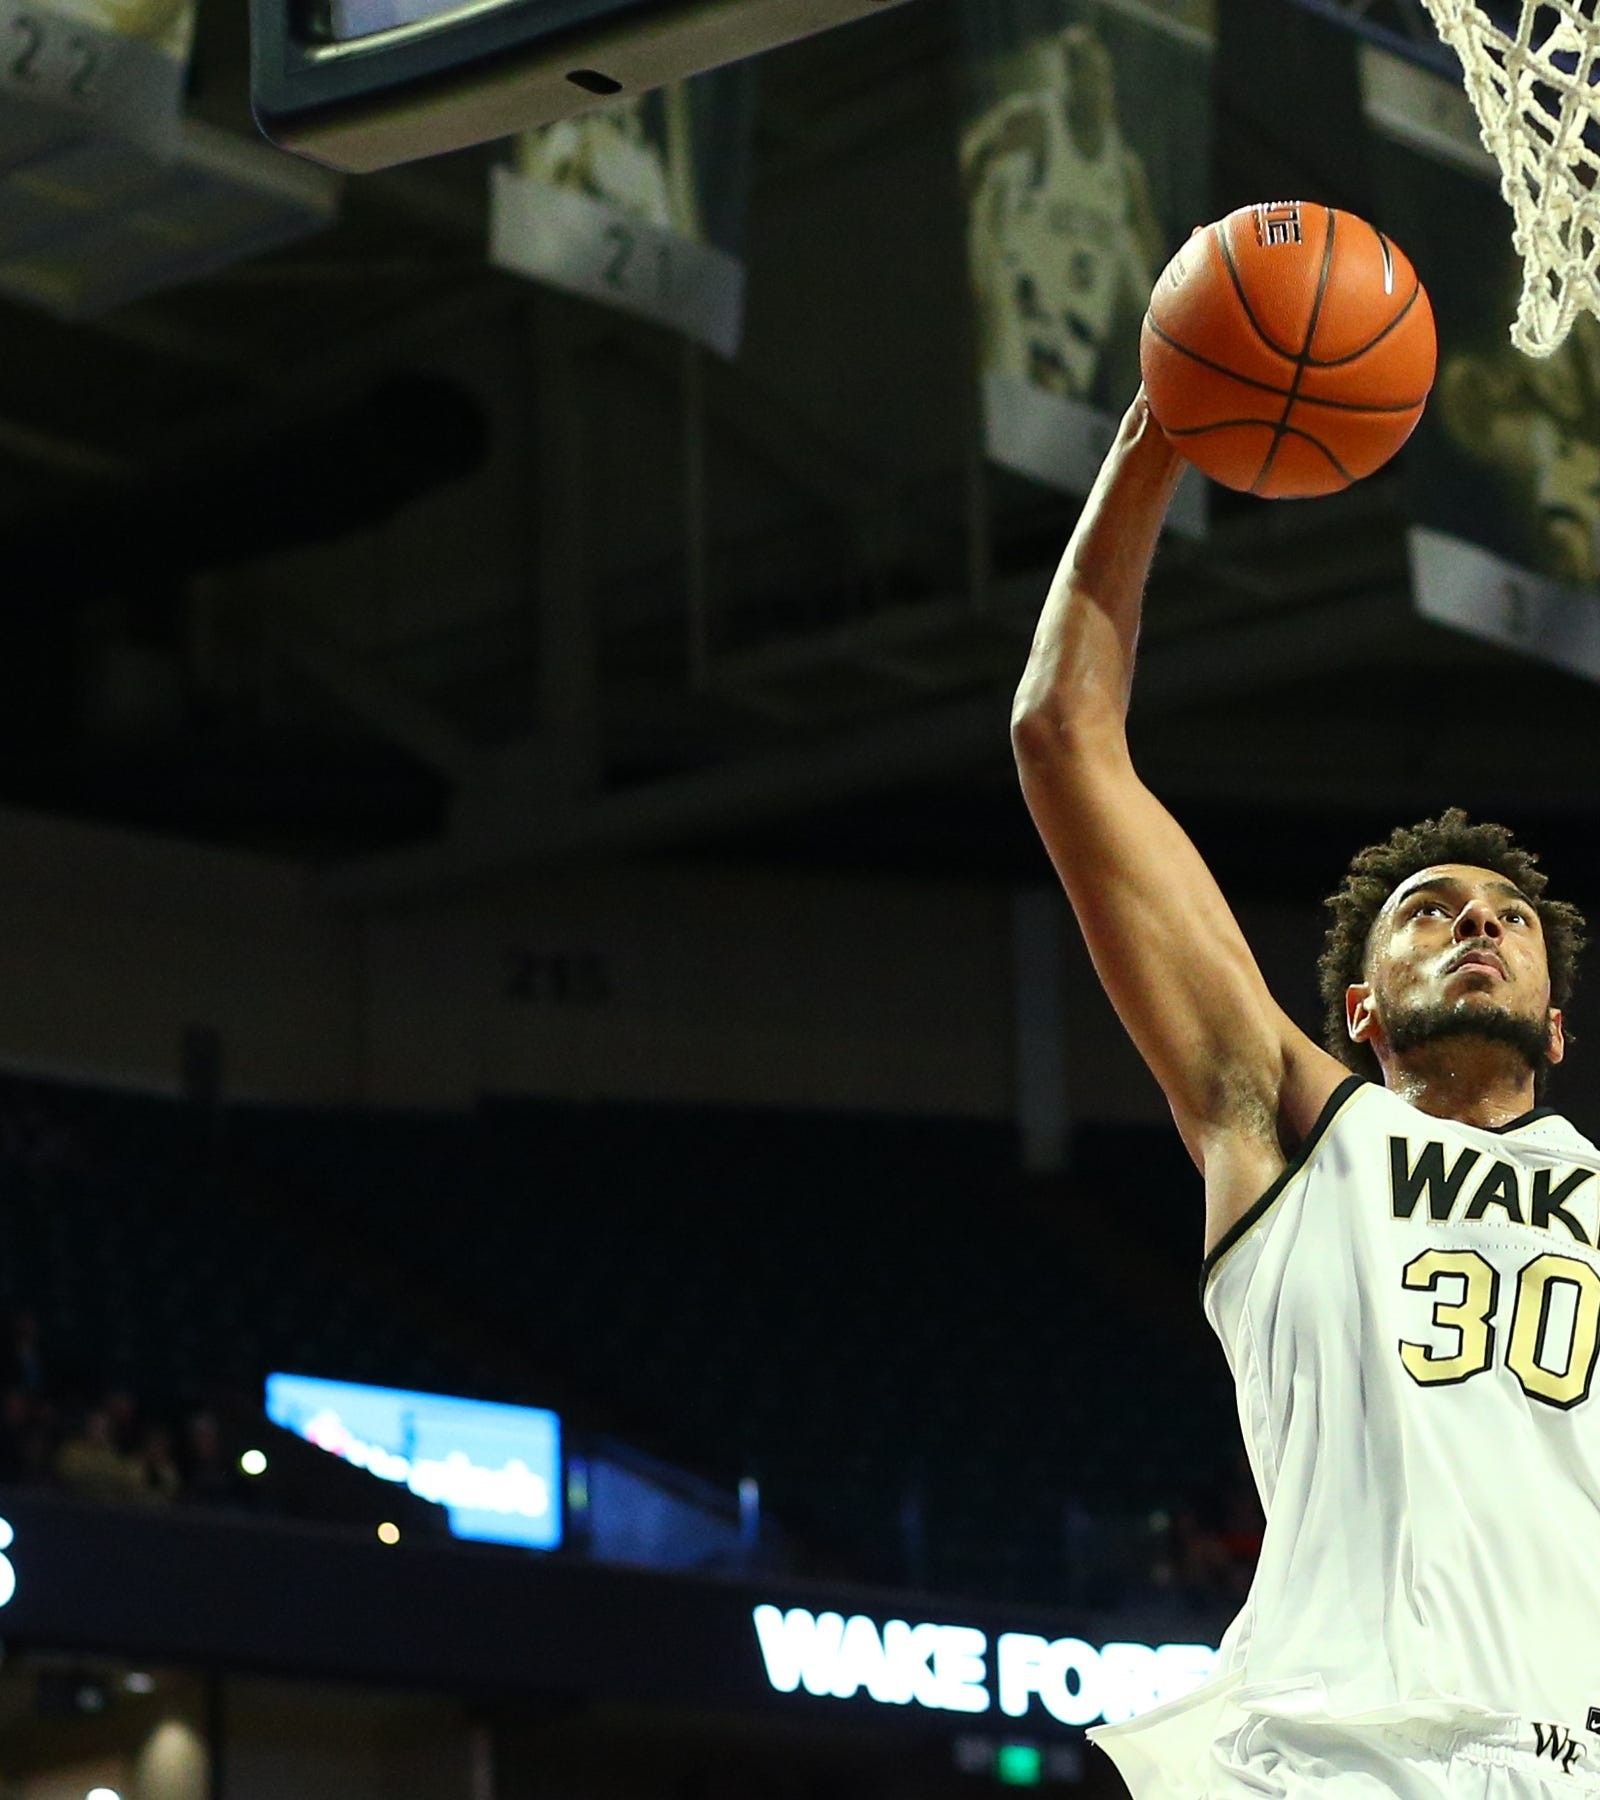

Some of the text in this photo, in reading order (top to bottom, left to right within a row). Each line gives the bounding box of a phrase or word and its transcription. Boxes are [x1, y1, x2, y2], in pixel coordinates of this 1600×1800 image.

[753, 1604, 1222, 1726] WAKE FORE
[1531, 1721, 1587, 1776] WF
